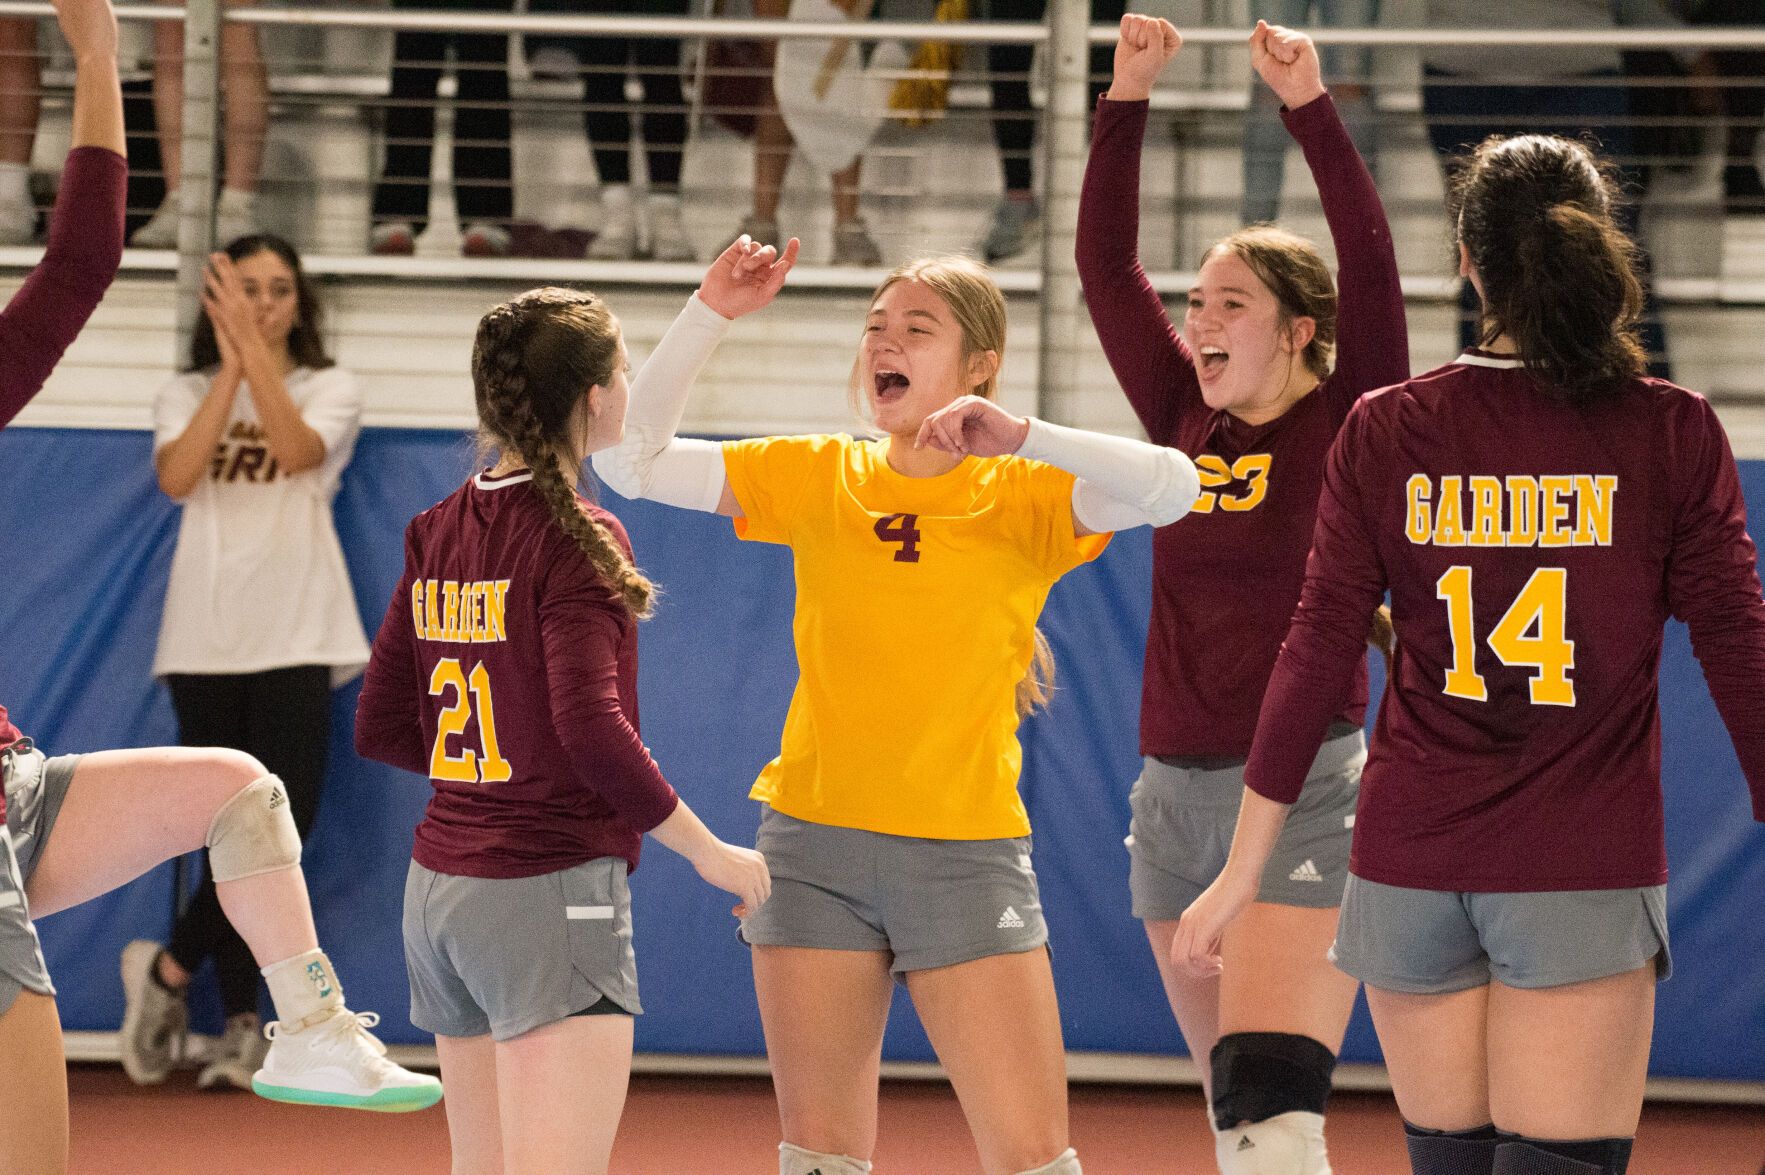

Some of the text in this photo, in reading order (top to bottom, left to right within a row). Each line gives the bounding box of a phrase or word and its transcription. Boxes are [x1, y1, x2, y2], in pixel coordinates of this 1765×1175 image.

[1191, 453, 1272, 514] 23
[1405, 473, 1618, 547] GARDEN
[873, 513, 920, 563] 4
[412, 578, 510, 643] GARDEN
[1436, 566, 1576, 707] 14
[428, 657, 512, 783] 21
[996, 920, 1024, 928] adidas
